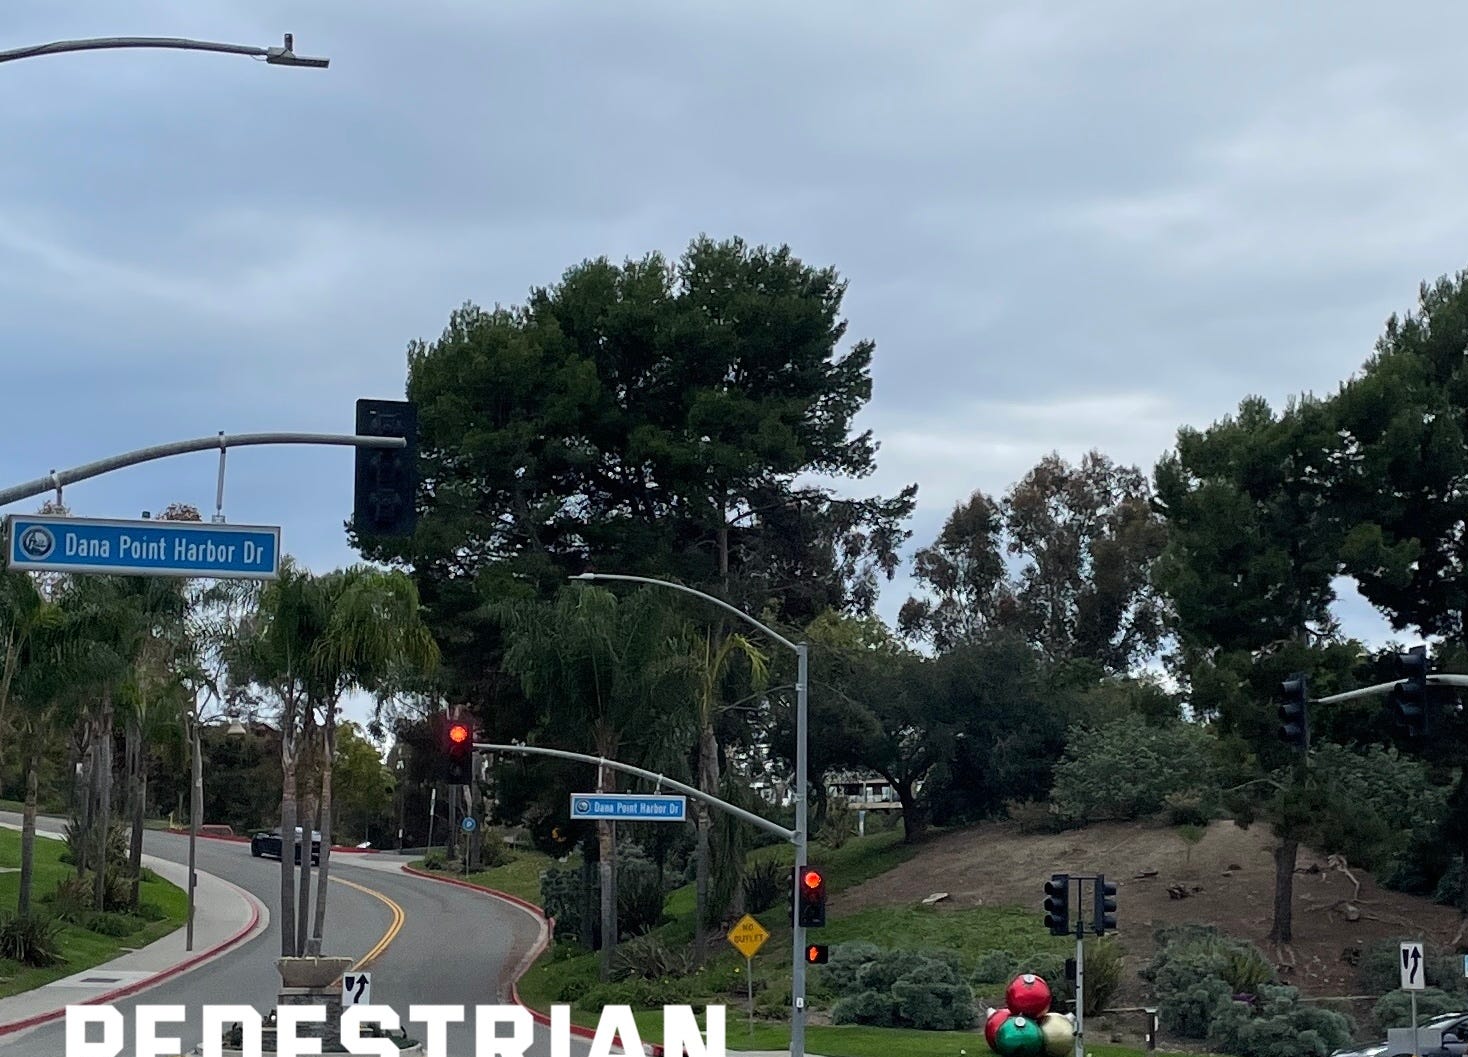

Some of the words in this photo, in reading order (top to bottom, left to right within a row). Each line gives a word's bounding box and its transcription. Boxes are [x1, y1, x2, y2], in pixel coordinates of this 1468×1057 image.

[65, 532, 110, 558] Dana
[119, 535, 166, 560] Point
[173, 538, 235, 563] Harbor
[243, 540, 264, 565] Dr
[594, 801, 614, 813] Dana
[617, 802, 638, 814] Point
[640, 802, 667, 815] Harbor
[669, 803, 679, 815] Dr
[742, 923, 754, 931] NO
[734, 933, 764, 943] OUTLET
